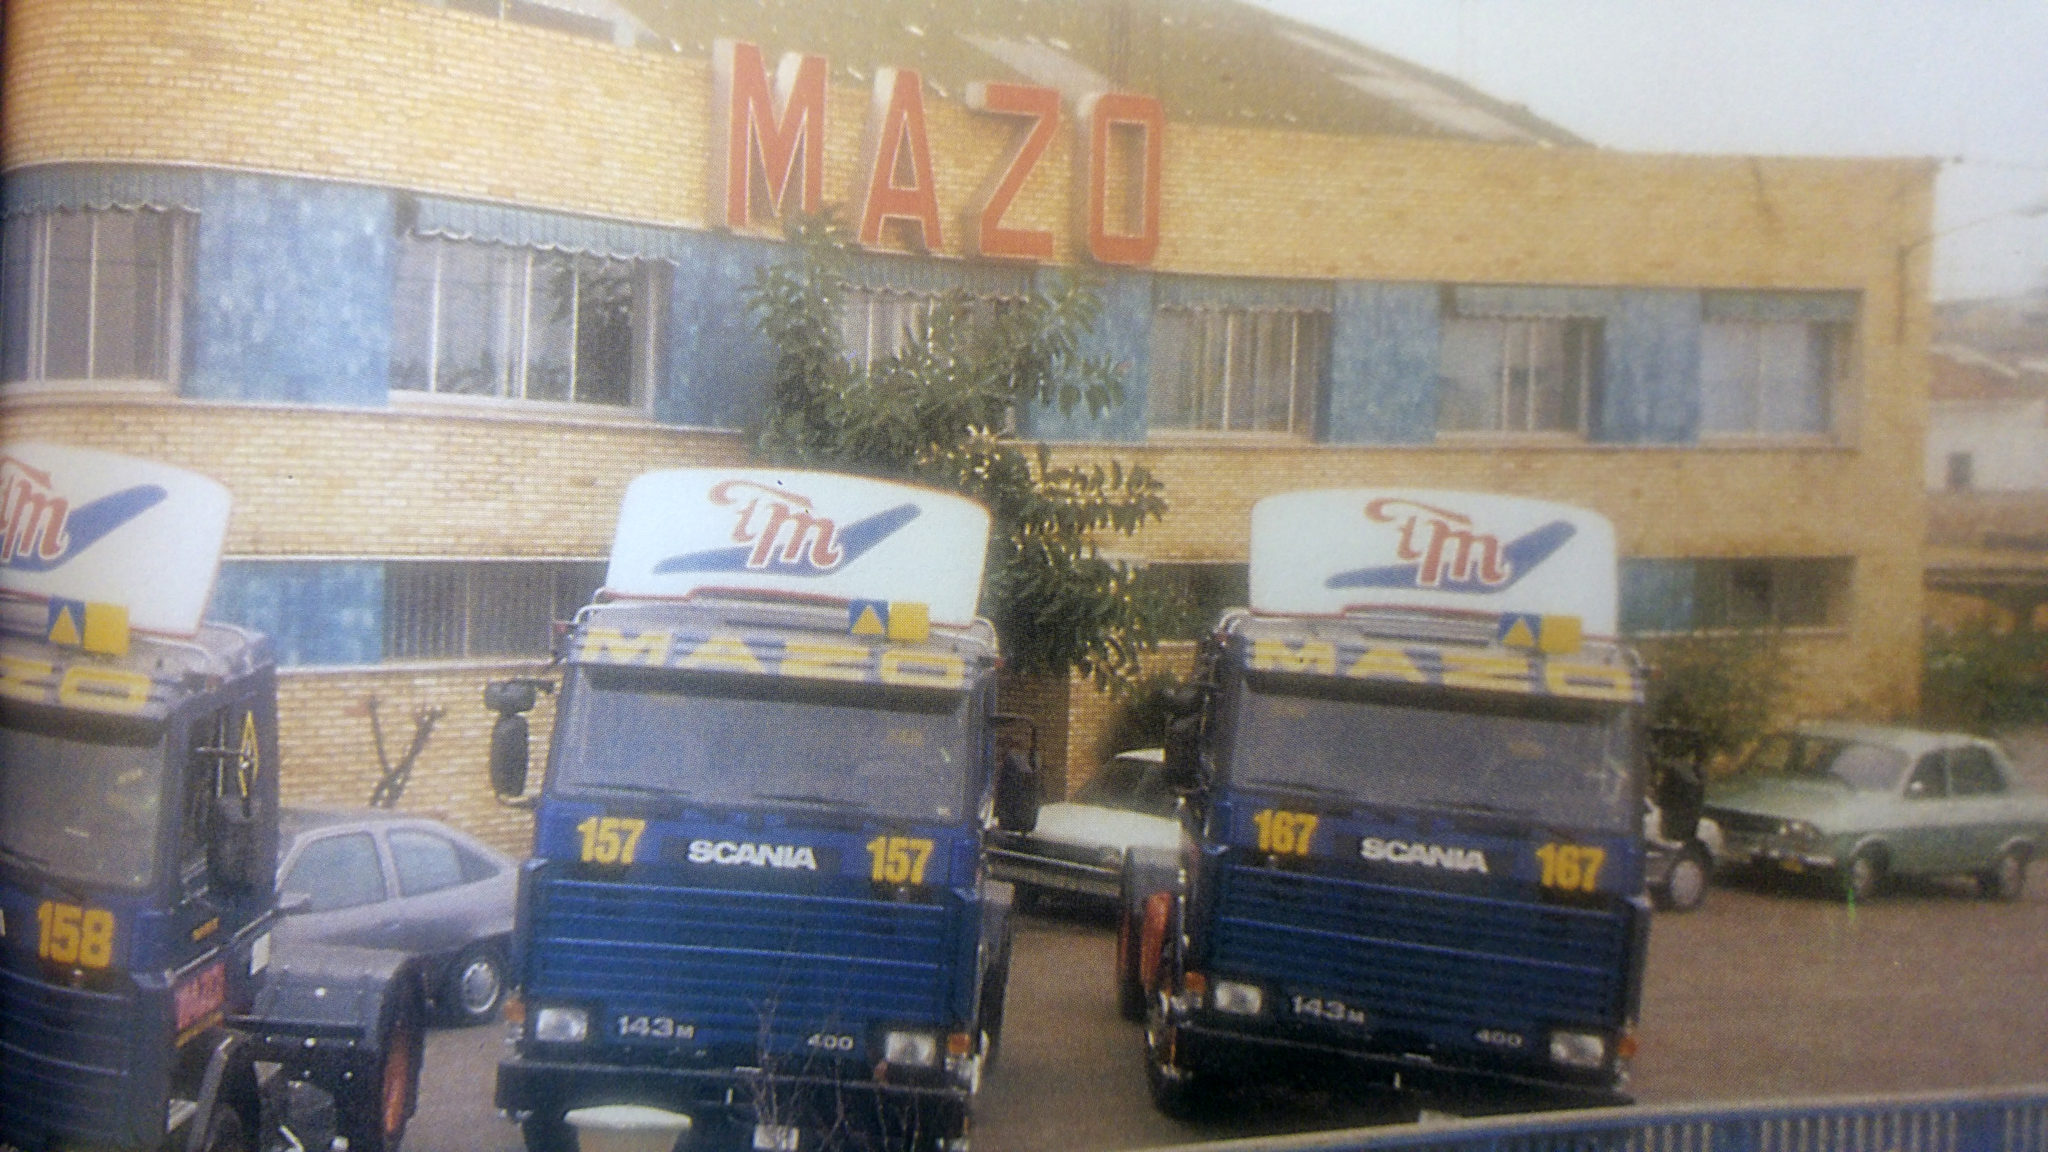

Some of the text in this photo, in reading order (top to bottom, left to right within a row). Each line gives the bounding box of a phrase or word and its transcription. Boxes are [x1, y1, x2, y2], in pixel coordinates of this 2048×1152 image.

[713, 38, 1164, 266] MAZO
[579, 627, 967, 690] MAZO
[1250, 641, 1633, 699] MAZO
[577, 816, 647, 866] 157
[688, 840, 817, 870] SCANIA
[1253, 809, 1319, 856] 167
[1361, 837, 1488, 873] SCANIA
[866, 835, 934, 884] 157
[1535, 843, 1606, 892] 167
[37, 900, 114, 969] 158
[807, 1034, 853, 1051] 400
[1475, 1029, 1524, 1048] 400
